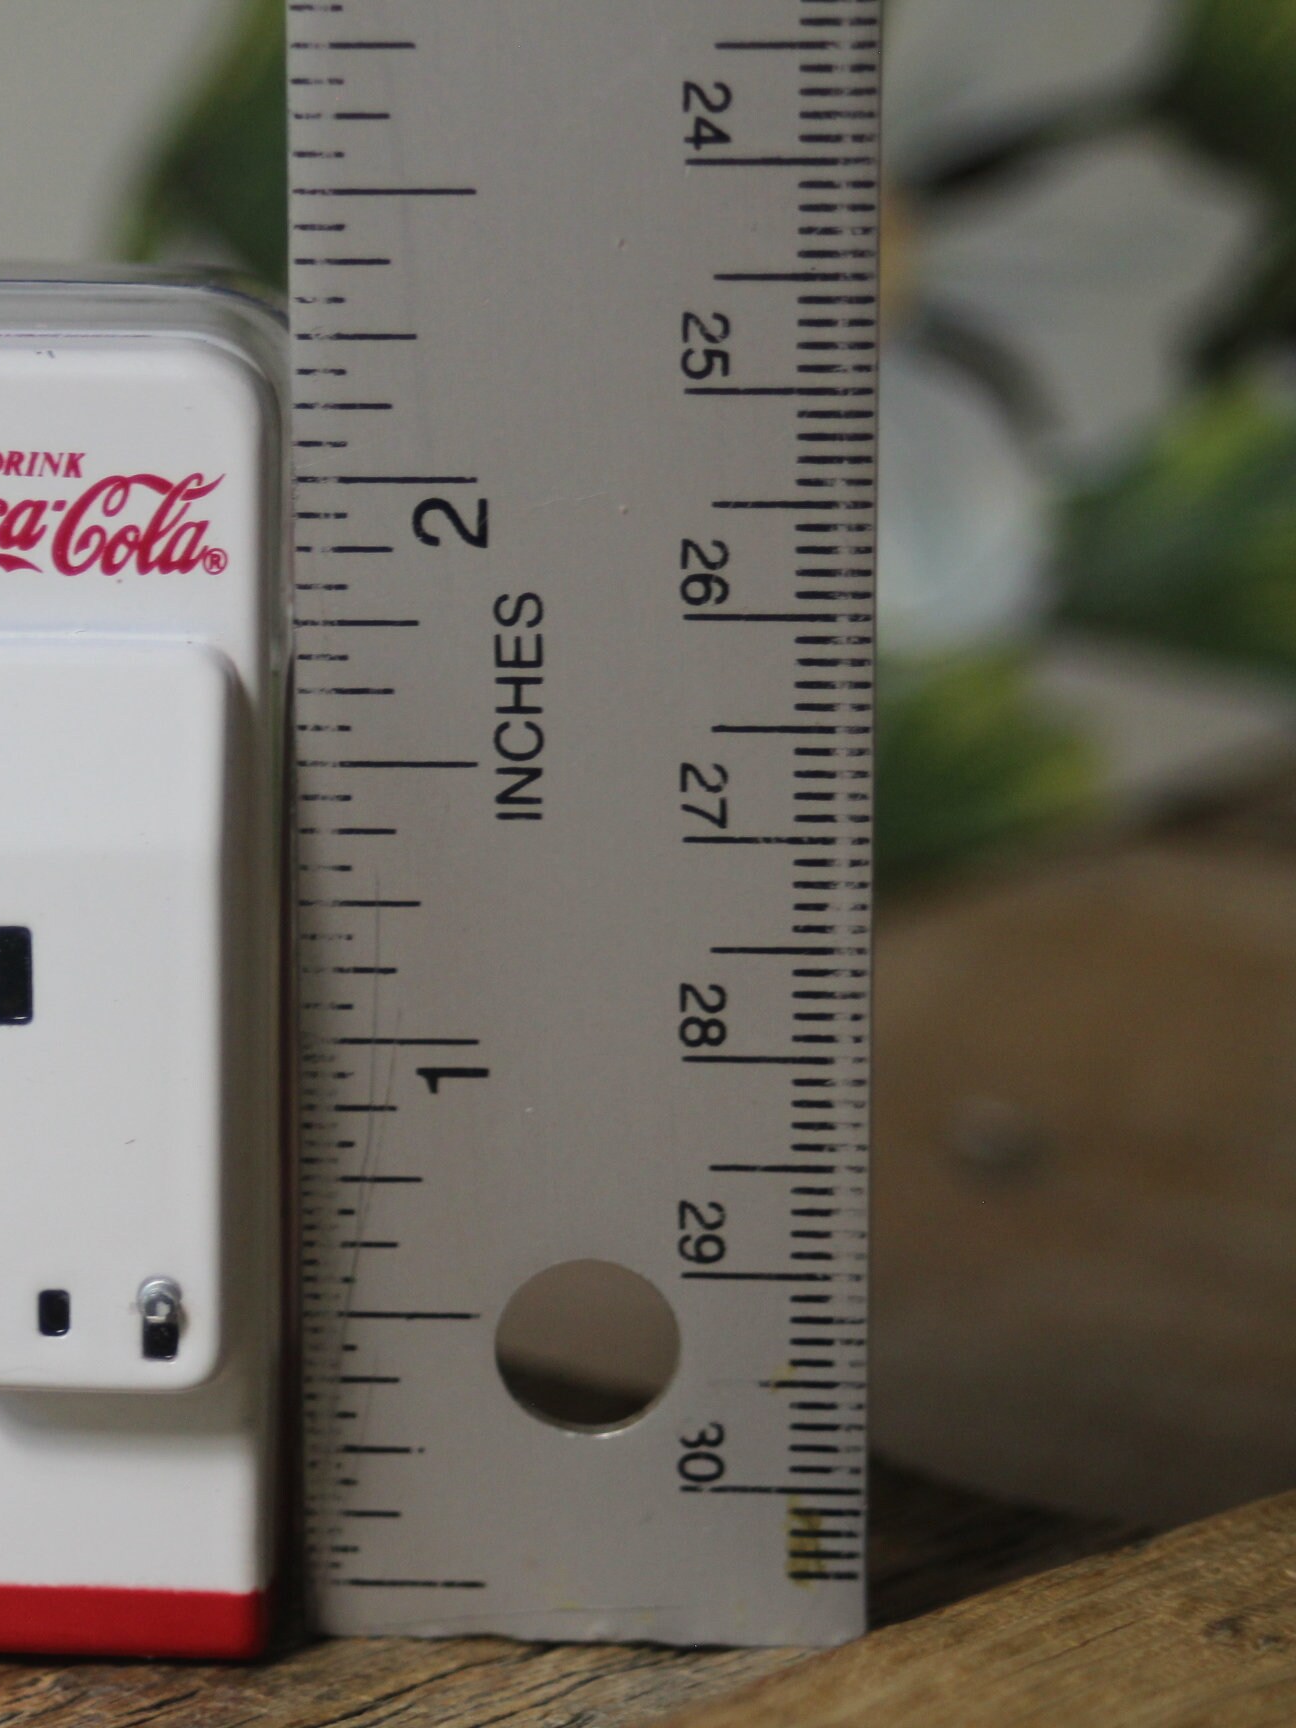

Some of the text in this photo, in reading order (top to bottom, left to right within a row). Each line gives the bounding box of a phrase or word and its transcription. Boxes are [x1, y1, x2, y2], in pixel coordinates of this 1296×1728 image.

[682, 80, 733, 151] 24
[680, 311, 731, 381] 25
[411, 497, 489, 549] 2
[679, 538, 730, 607] 26
[493, 591, 546, 821] INCHES
[679, 761, 729, 830] 27
[678, 982, 728, 1048] 28
[415, 1066, 491, 1095] 1
[677, 1199, 727, 1265] 29
[677, 1422, 726, 1484] 30
